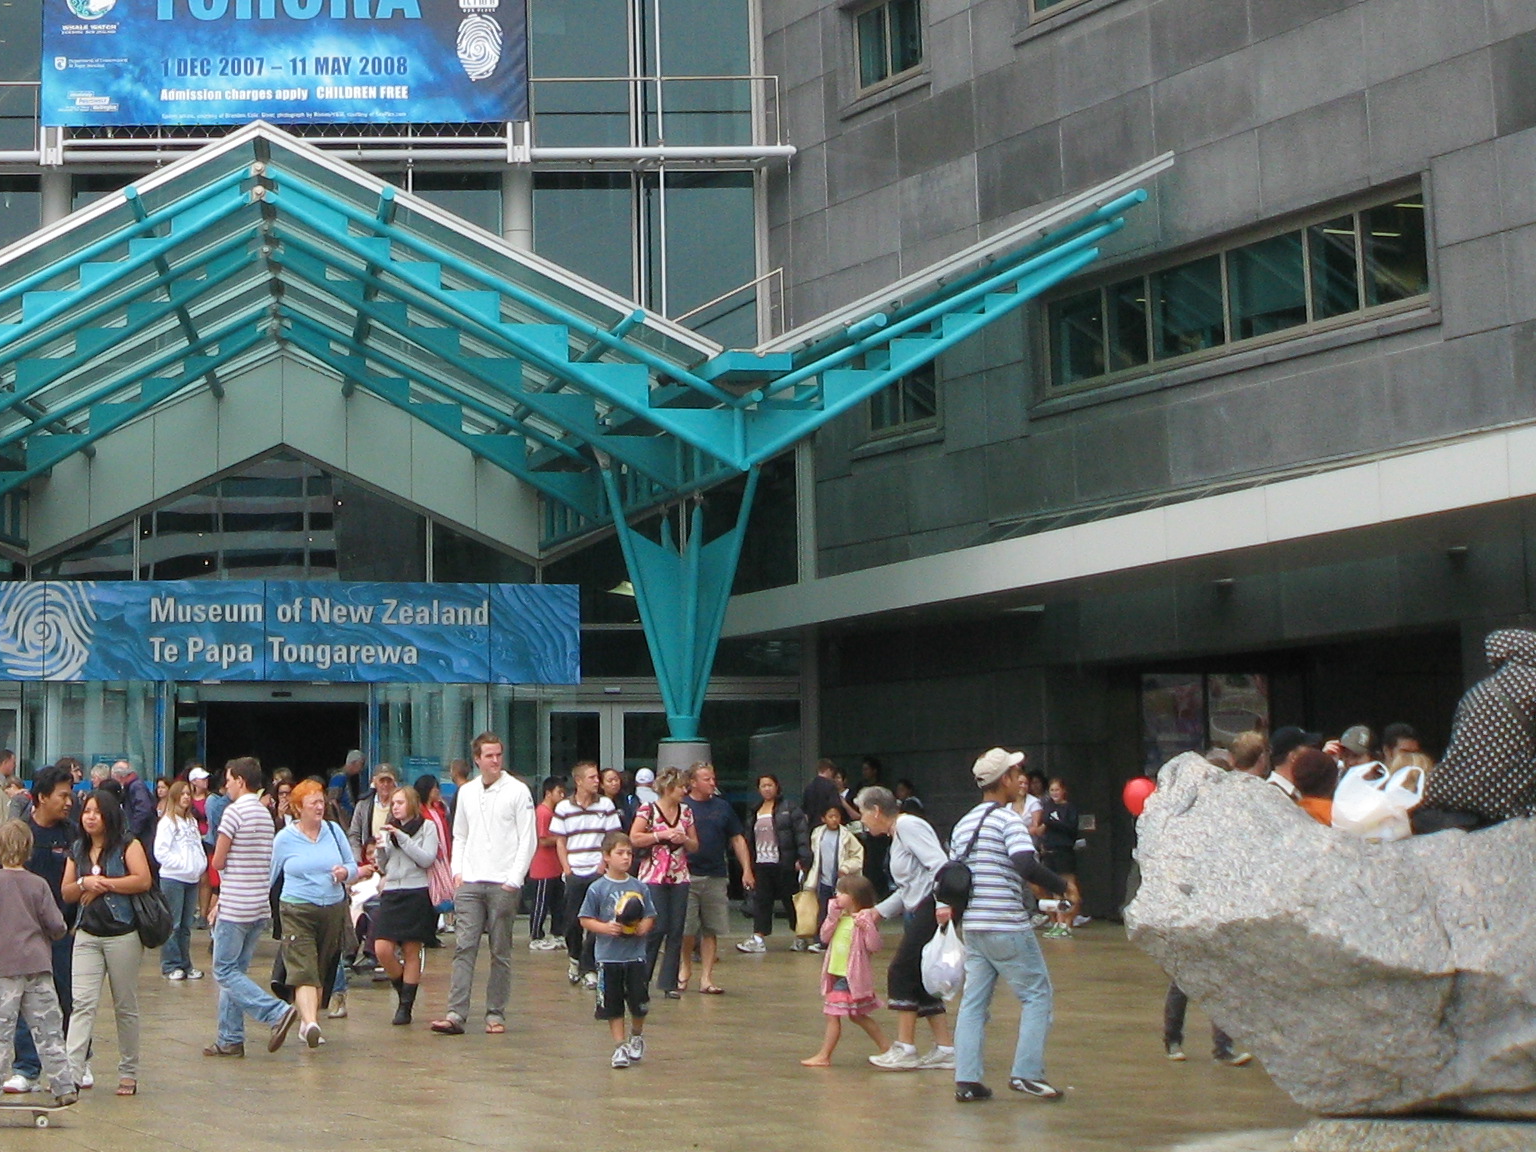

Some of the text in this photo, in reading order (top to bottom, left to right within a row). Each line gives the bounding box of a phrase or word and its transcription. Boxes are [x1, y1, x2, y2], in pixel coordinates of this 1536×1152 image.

[161, 57, 169, 77] 1
[176, 57, 212, 77] DEC
[218, 57, 265, 77] 2007
[288, 56, 307, 76] 11
[314, 56, 352, 76] MAY
[358, 56, 408, 76] 2008
[160, 85, 409, 102] Admission charges apply CHILDREN FREE
[150, 597, 490, 626] Museum of New Zealand
[149, 636, 419, 670] Te Papa Tongarewa
